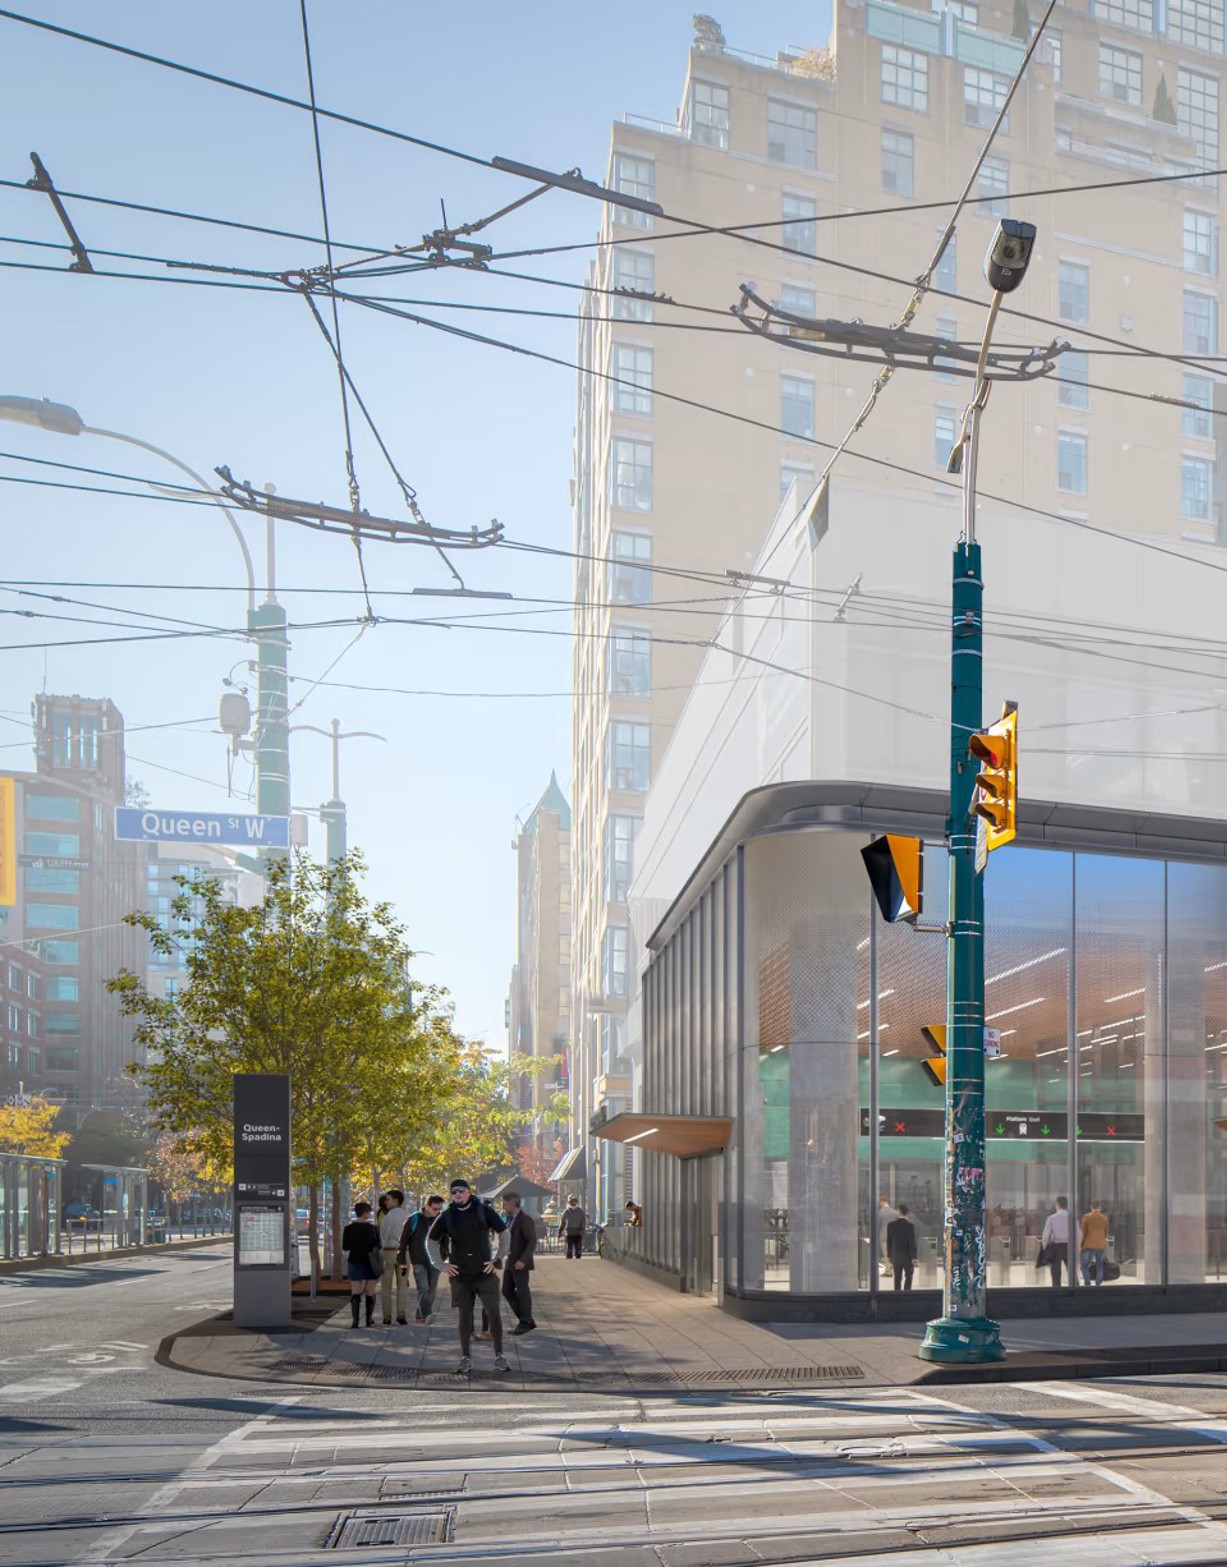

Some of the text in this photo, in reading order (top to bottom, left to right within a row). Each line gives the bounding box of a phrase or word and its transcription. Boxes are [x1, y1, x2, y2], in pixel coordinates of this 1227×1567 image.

[141, 813, 265, 838] Queen St W
[243, 1124, 280, 1133] Queen-
[241, 1133, 282, 1142] Spadina
